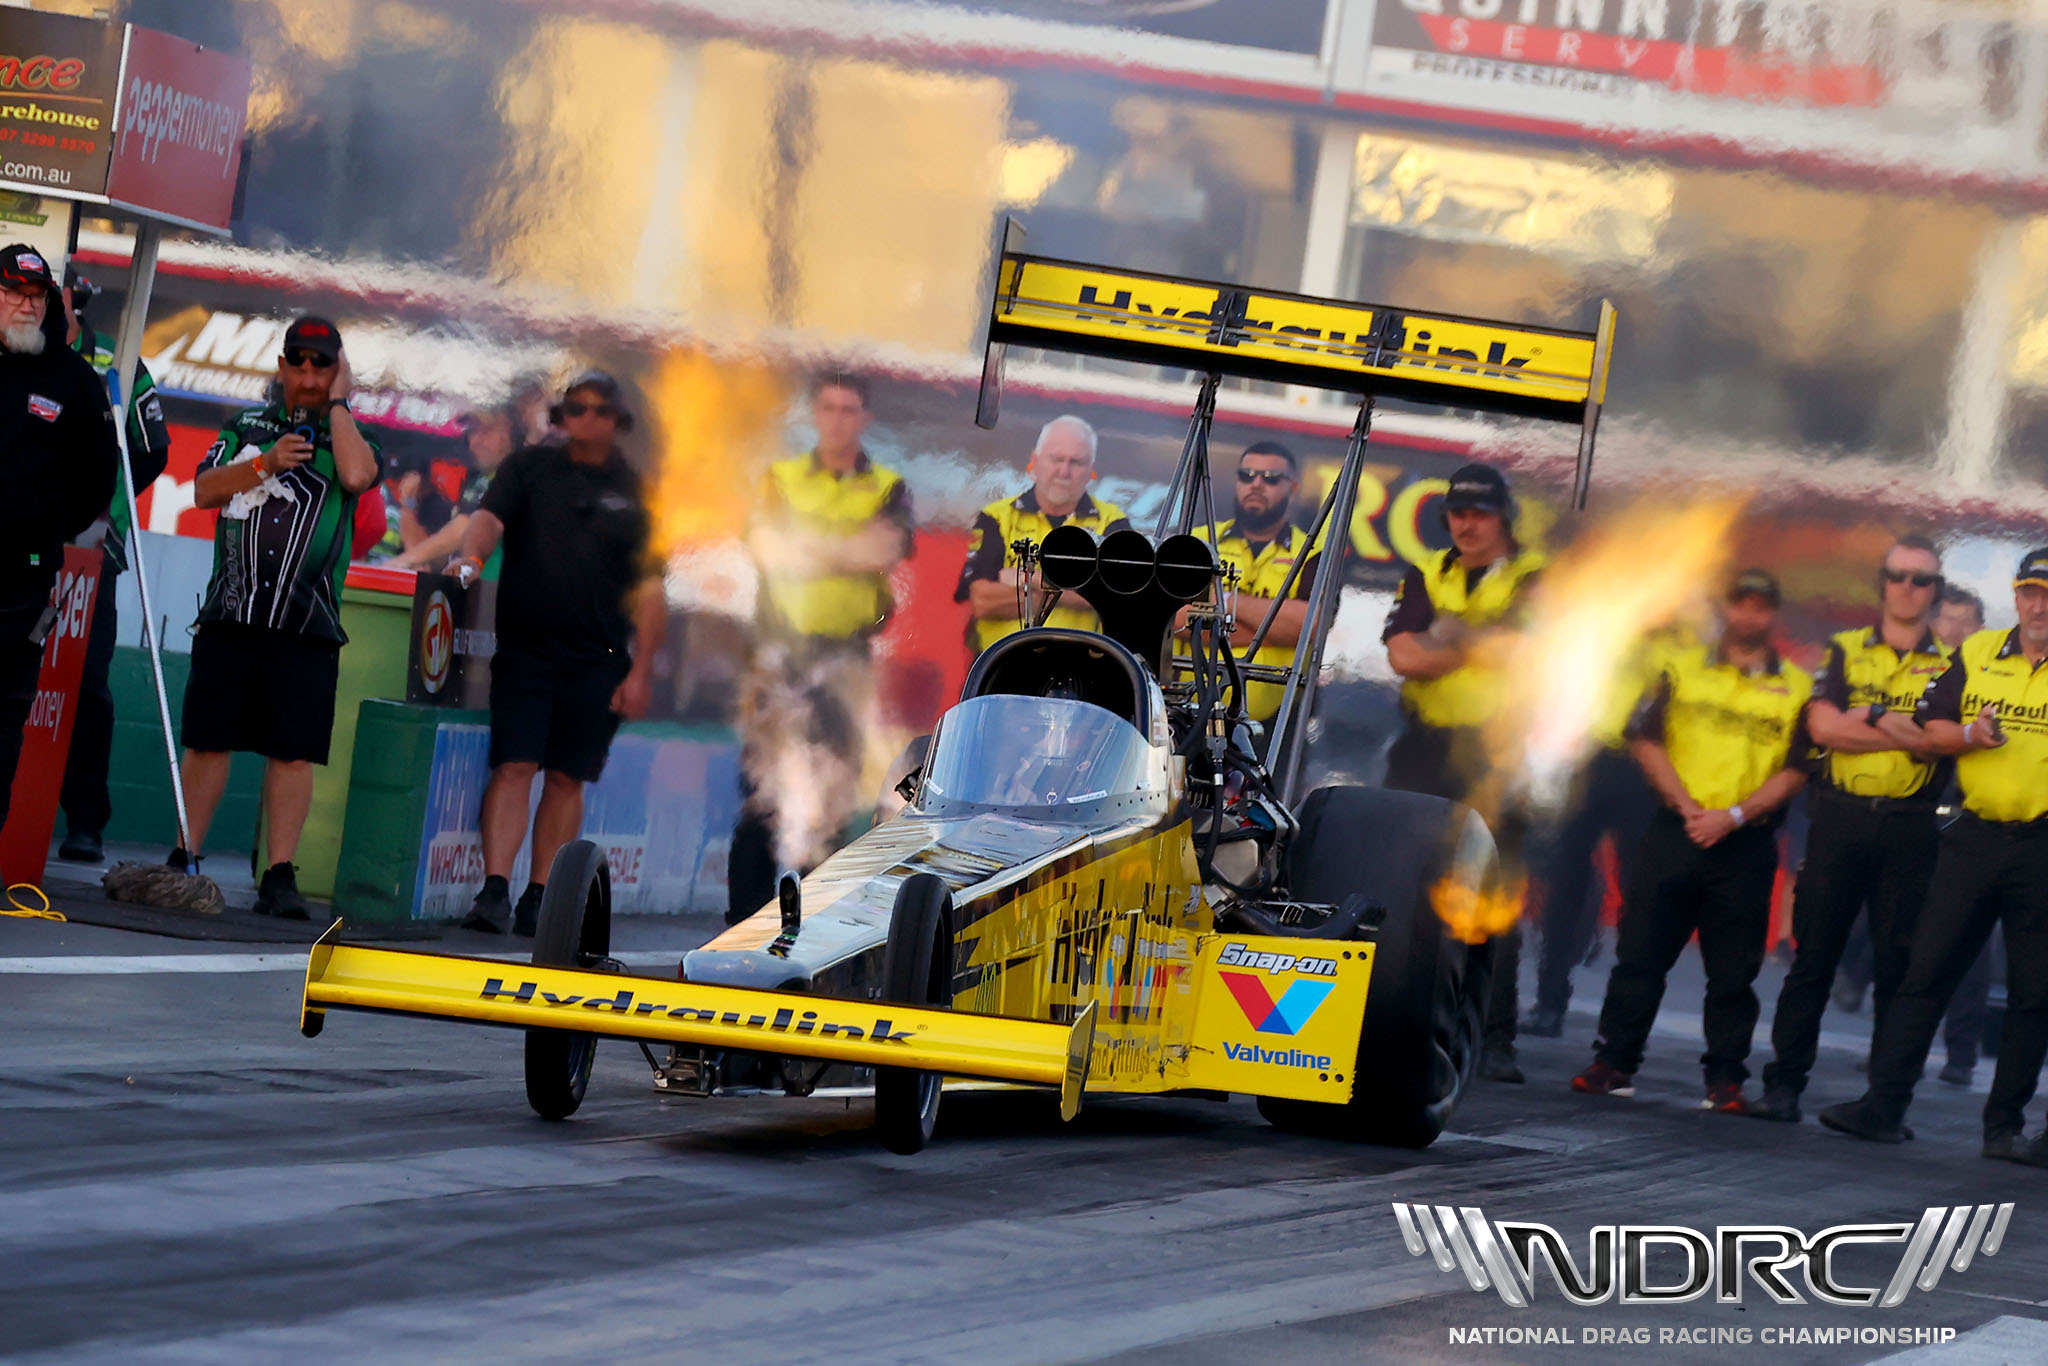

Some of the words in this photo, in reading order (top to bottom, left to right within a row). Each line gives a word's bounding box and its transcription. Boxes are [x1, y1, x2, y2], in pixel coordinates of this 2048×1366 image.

[0, 103, 100, 131] rehouse
[120, 76, 241, 179] peppermoney
[25, 688, 66, 743] oney
[1216, 942, 1338, 977] Snap-on
[478, 978, 918, 1046] Hydraulink
[1222, 1041, 1332, 1071] Valvoline
